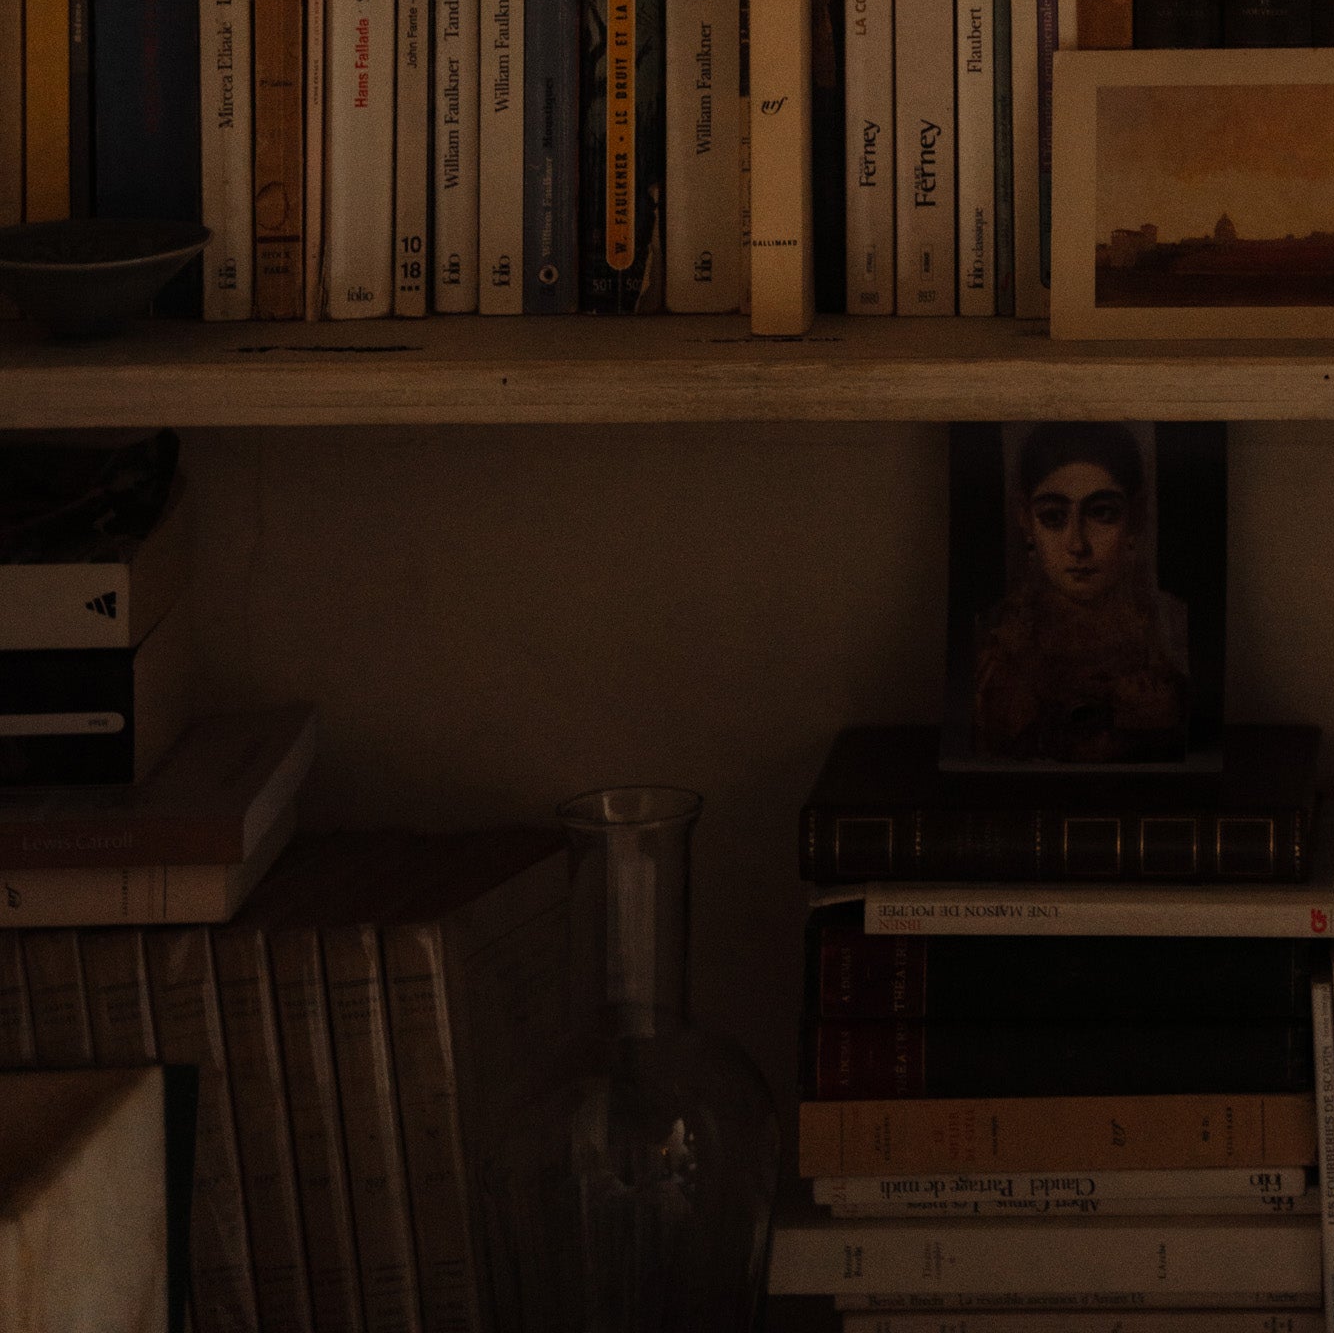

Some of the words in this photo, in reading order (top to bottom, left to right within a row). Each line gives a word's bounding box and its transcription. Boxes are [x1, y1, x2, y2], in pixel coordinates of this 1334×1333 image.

[494, 54, 510, 113] William
[760, 96, 787, 117] nrf
[859, 120, 881, 187] Ferney
[914, 119, 941, 208] Ferney
[402, 237, 421, 253] 10
[402, 262, 421, 279] 18
[492, 256, 511, 287] folio
[880, 1180, 920, 1198] midi
[924, 1179, 946, 1197] de
[951, 1175, 1014, 1196] Partage
[1029, 1178, 1096, 1196] Claudel
[1250, 1174, 1282, 1191] folio
